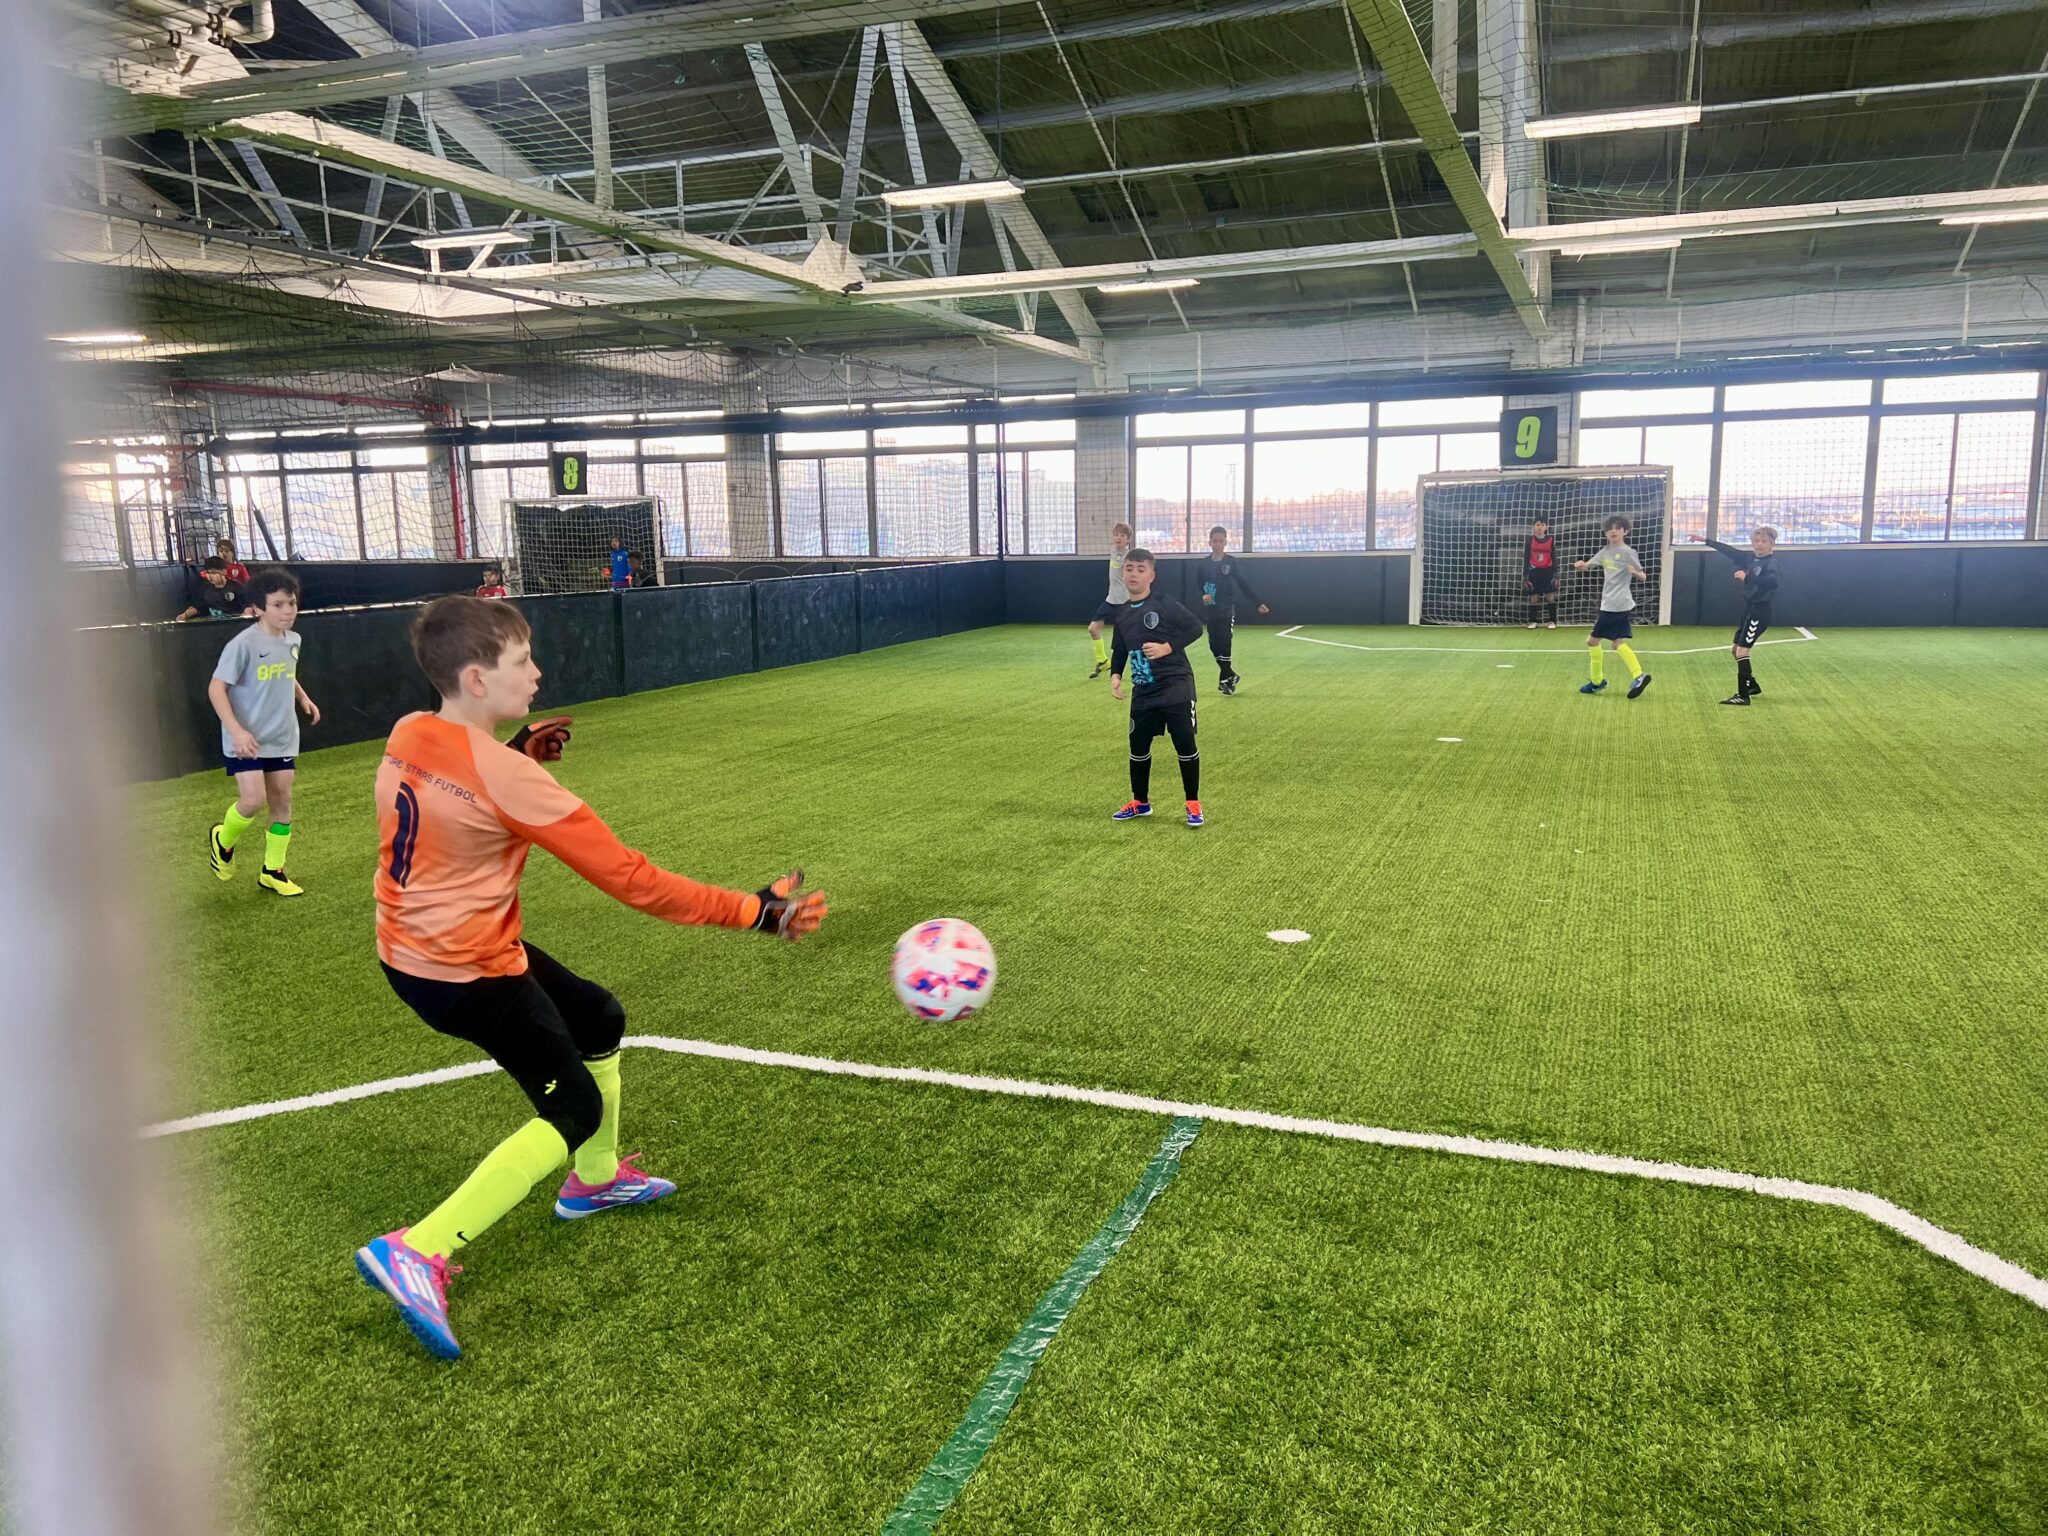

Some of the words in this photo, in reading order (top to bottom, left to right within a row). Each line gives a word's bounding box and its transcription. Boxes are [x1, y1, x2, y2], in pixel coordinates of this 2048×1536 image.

[1515, 416, 1541, 459] 9
[563, 456, 579, 490] 8
[405, 763, 433, 783] STARS
[434, 778, 478, 804] FUTBOL
[390, 781, 419, 889] 1
